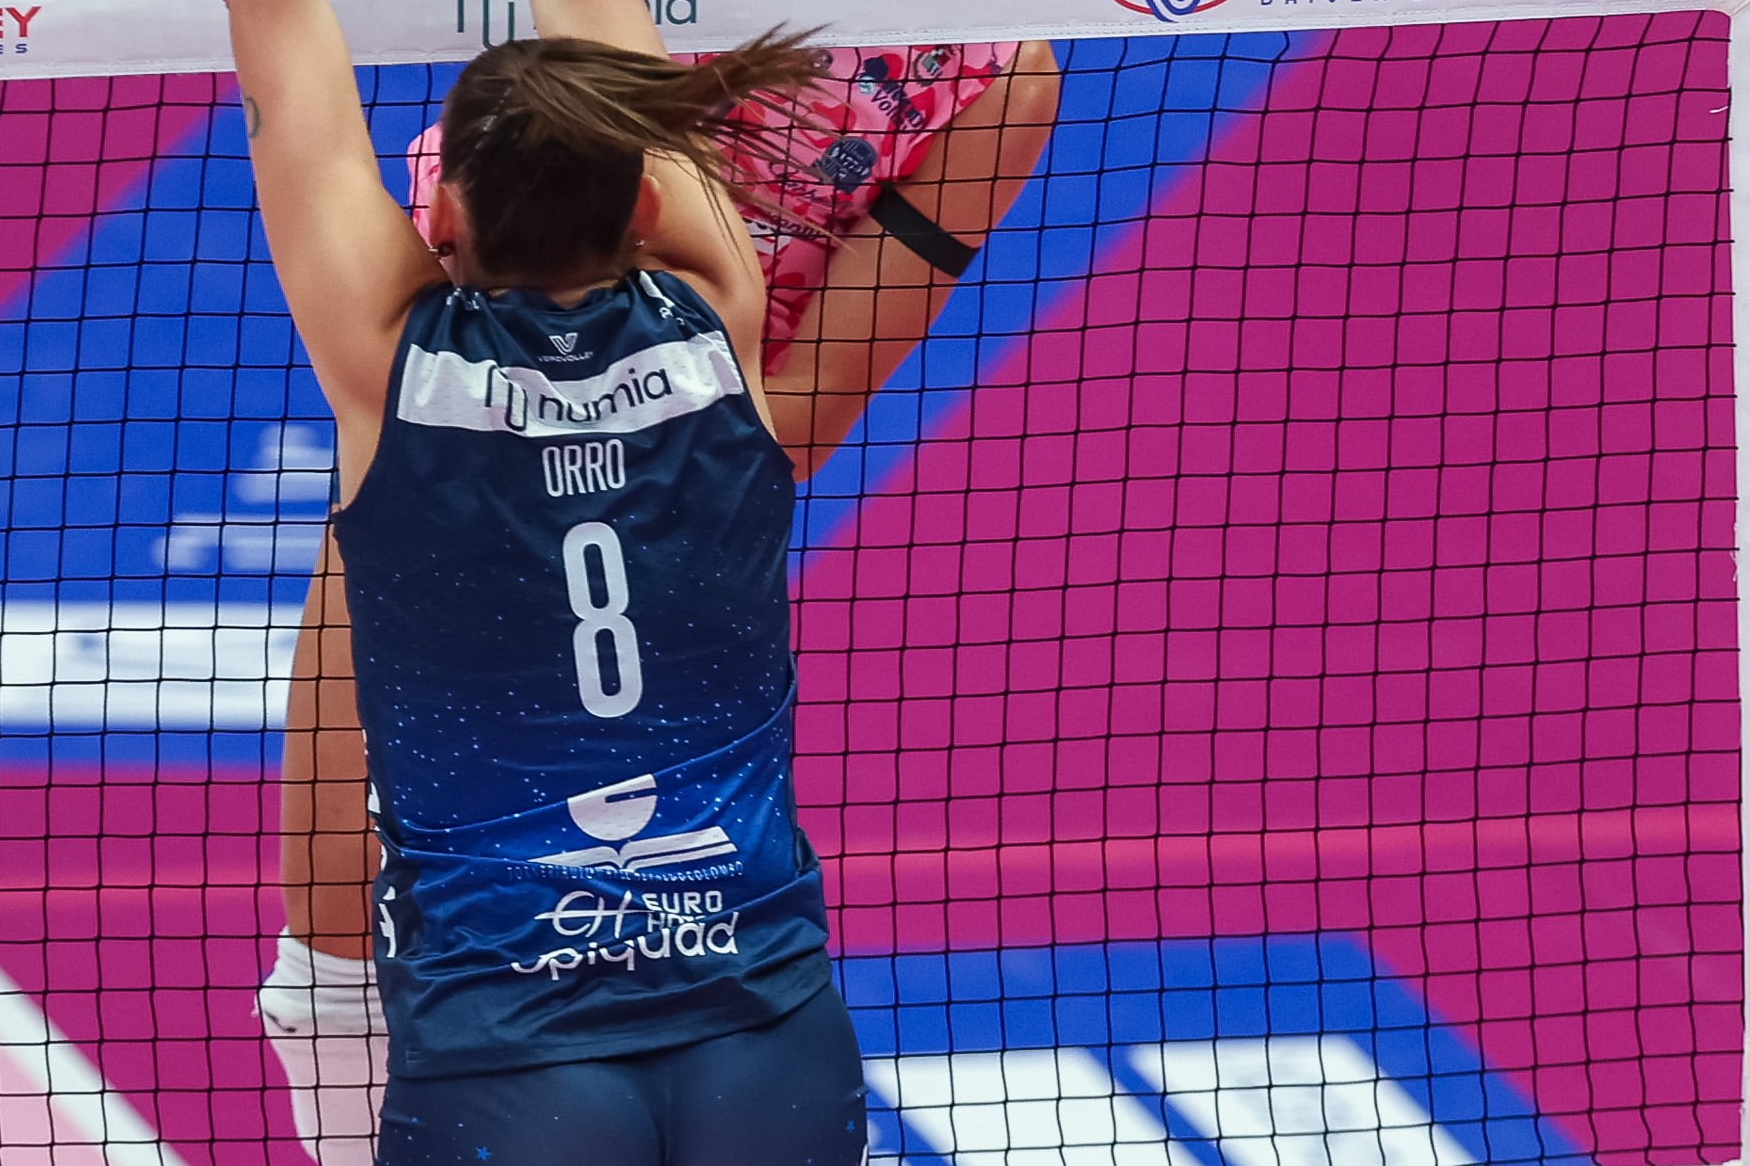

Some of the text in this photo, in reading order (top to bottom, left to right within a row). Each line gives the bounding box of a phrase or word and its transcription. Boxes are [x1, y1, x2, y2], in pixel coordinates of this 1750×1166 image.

[538, 364, 673, 424] numia
[541, 437, 625, 498] ORRO
[562, 521, 644, 719] 8
[641, 890, 723, 914] EURO
